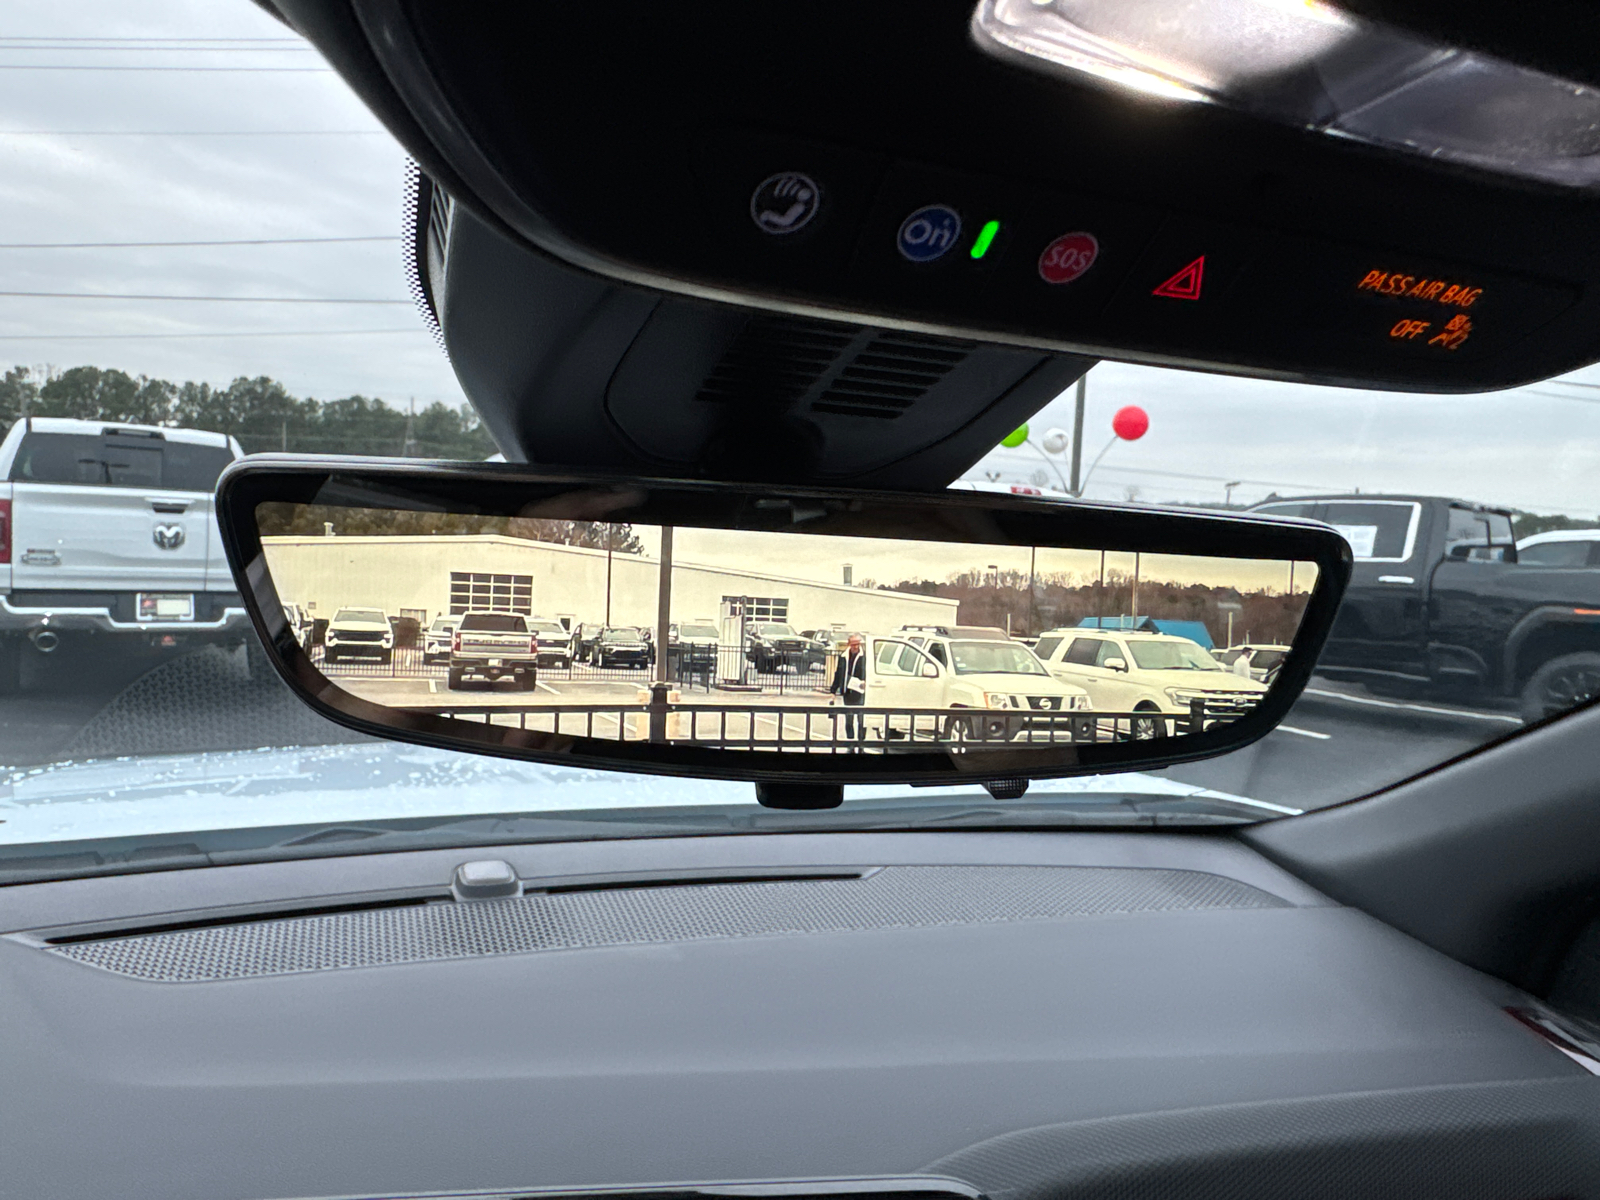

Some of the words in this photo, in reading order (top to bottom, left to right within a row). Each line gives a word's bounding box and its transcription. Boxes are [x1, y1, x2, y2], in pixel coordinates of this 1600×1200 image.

[1045, 246, 1091, 271] SOS
[1357, 269, 1415, 295] PASS
[1407, 278, 1446, 300] AIR
[1438, 284, 1483, 307] BAG
[1389, 319, 1431, 339] OFF
